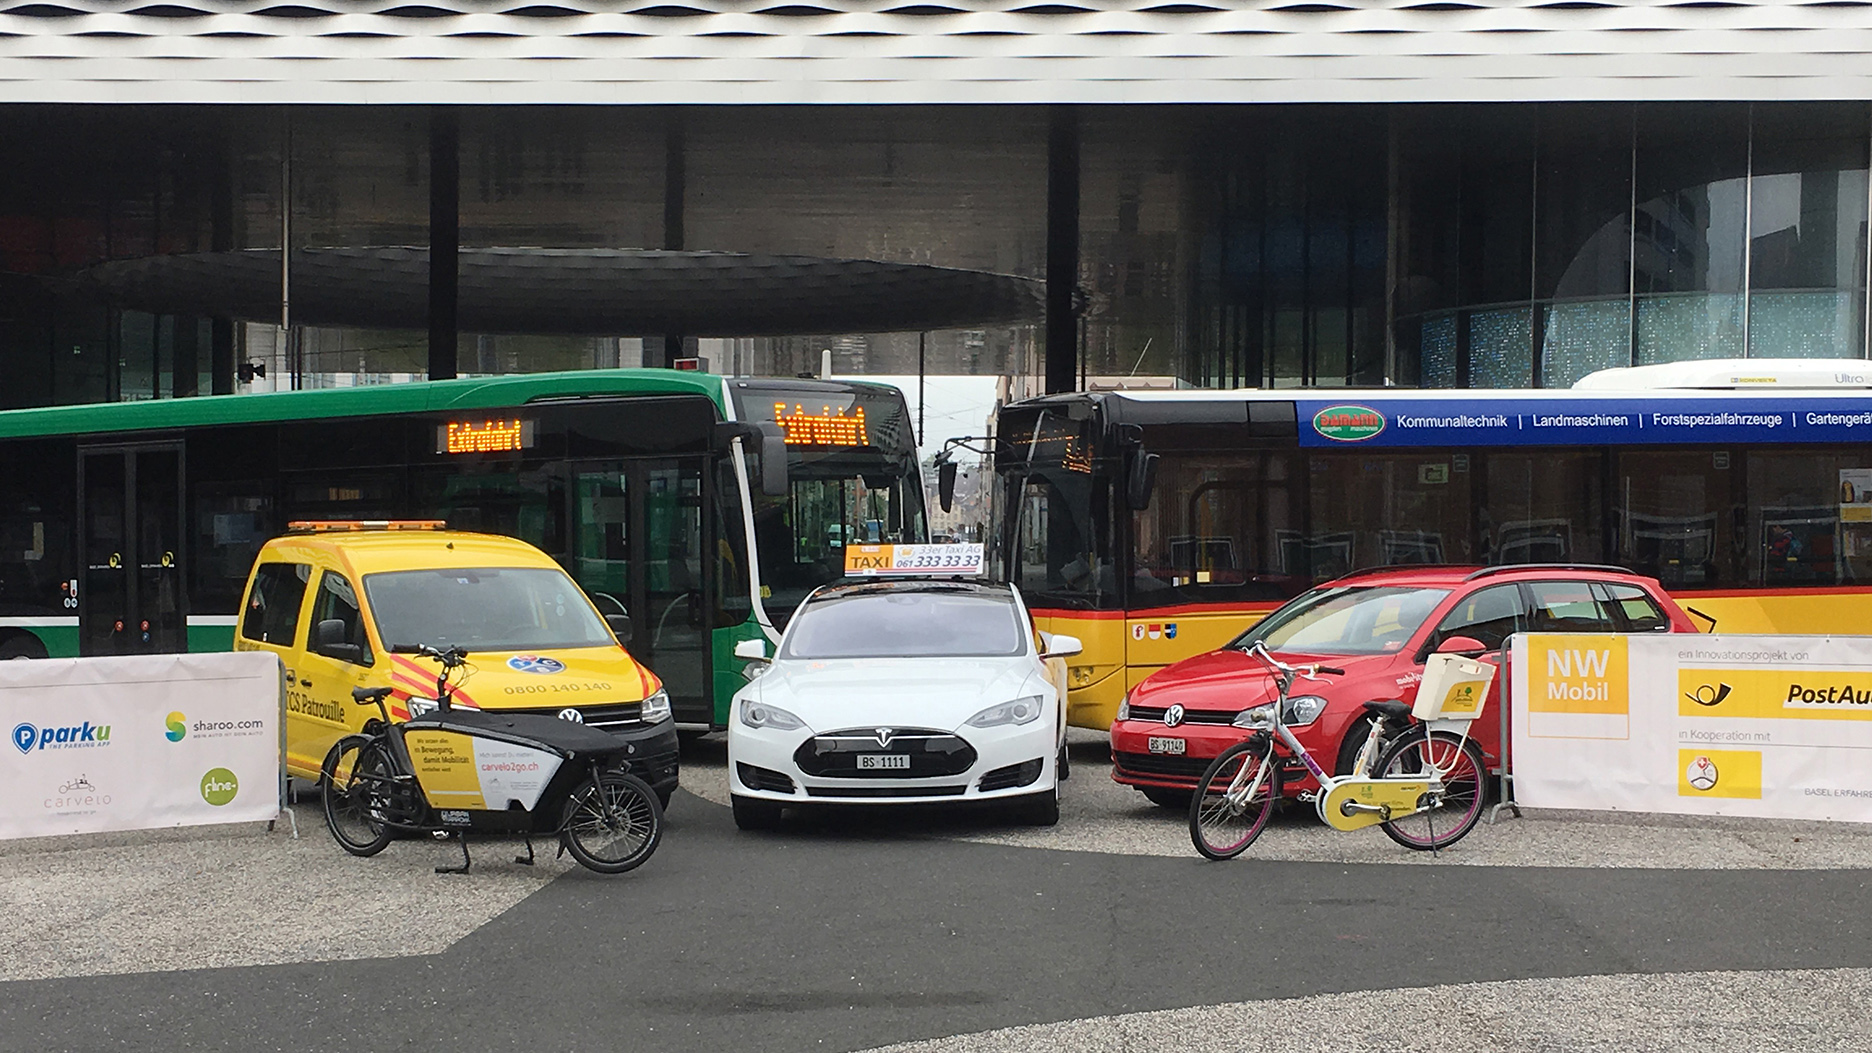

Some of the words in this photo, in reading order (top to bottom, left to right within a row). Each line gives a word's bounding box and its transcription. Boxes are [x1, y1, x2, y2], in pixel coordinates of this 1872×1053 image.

[1396, 414, 1508, 429] Kommunaltechnik
[1532, 413, 1629, 427] Landmaschinen
[1652, 412, 1783, 428] Forstspezialfahrzeuge
[1805, 412, 1872, 428] Gartengerä
[448, 418, 522, 453] Extrafahrt
[919, 545, 942, 555] 33er
[945, 545, 965, 555] Taxi
[965, 545, 981, 554] AG
[851, 556, 890, 569] TAXI
[896, 560, 913, 568] 061
[913, 555, 942, 568] 333
[942, 555, 961, 567] 33
[962, 554, 981, 567] 33
[1547, 648, 1611, 678] NW
[1678, 651, 1693, 659] ein
[1695, 650, 1788, 664] Innovationsprojekt
[1790, 652, 1809, 661] von
[503, 685, 547, 695] 0800
[550, 683, 580, 692] 140
[583, 682, 613, 691] 140
[1548, 681, 1609, 701] Mobil
[1787, 684, 1872, 705] PostAu
[301, 694, 345, 723] Patrouille
[193, 720, 263, 731] sharoo.com
[39, 721, 111, 750] parku
[1679, 730, 1688, 738] in
[1690, 729, 1751, 741] Kooperation
[1753, 732, 1771, 741] mit
[64, 741, 95, 749] PARKING
[1151, 739, 1159, 749] BS
[481, 762, 540, 774] carvelo2go.ch
[862, 757, 875, 768] BS
[880, 756, 905, 768] 1111
[1804, 788, 1833, 797] BASEL
[43, 794, 112, 809] carvelo
